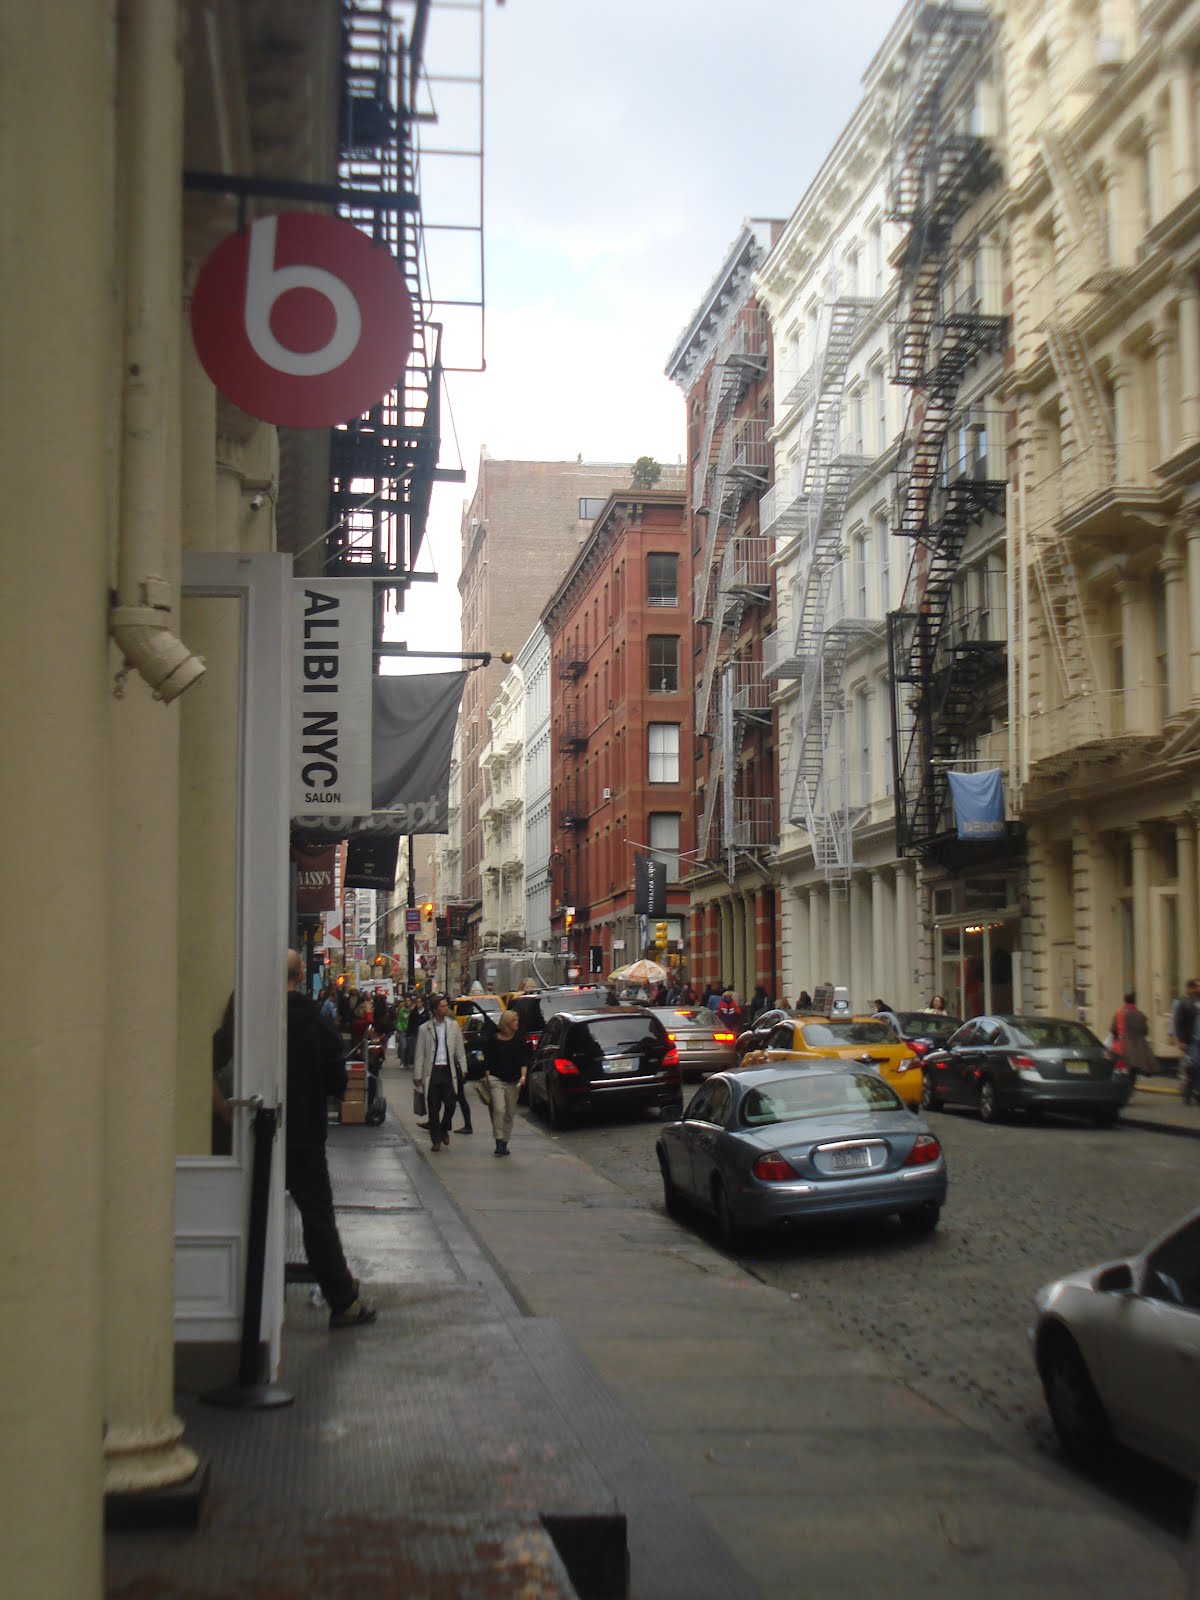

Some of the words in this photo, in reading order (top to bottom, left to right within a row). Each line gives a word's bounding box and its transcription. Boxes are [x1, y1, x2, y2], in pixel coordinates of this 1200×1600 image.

[244, 214, 362, 377] b
[302, 589, 340, 693] ALIBI
[301, 711, 339, 788] NYC
[304, 792, 341, 803] SALON
